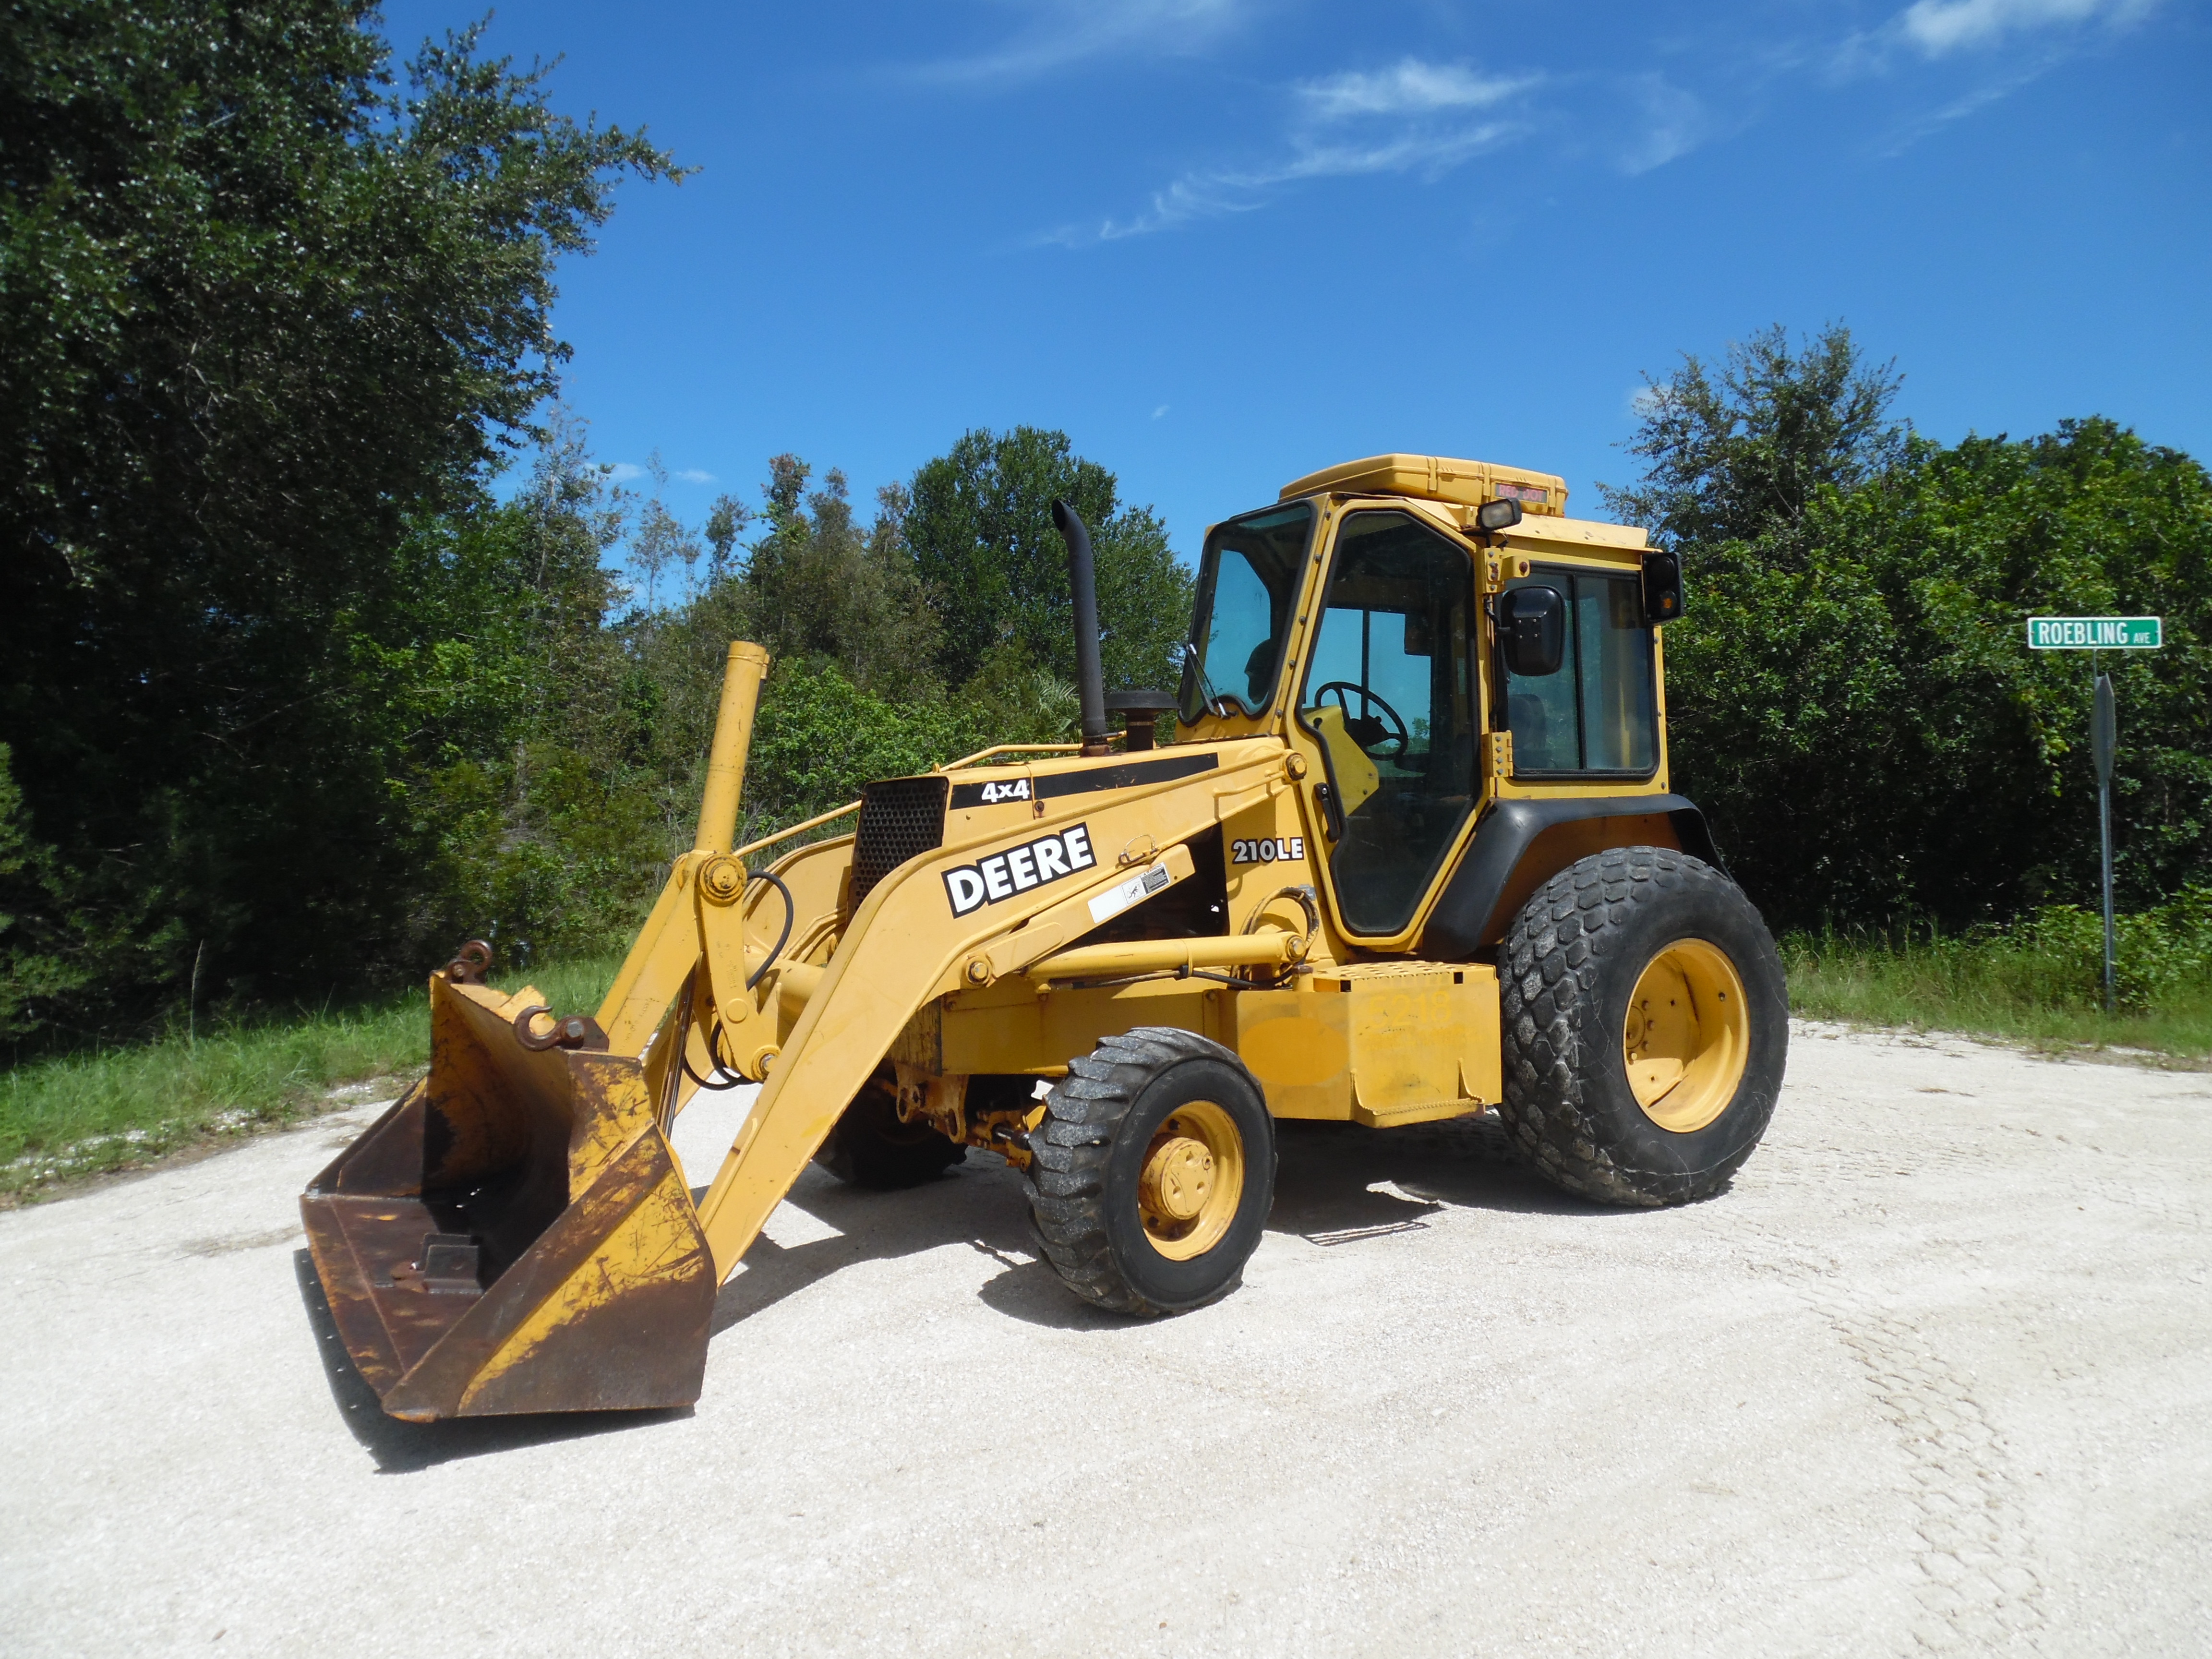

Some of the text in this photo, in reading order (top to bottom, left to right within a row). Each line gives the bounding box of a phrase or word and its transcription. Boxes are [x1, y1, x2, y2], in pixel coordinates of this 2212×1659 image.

[1499, 484, 1543, 501] RED DOT
[2039, 622, 2151, 644] ROEBLING AVE
[981, 779, 1030, 803] 4x4
[1233, 839, 1303, 862] 210LE
[947, 827, 1093, 913] DEERE
